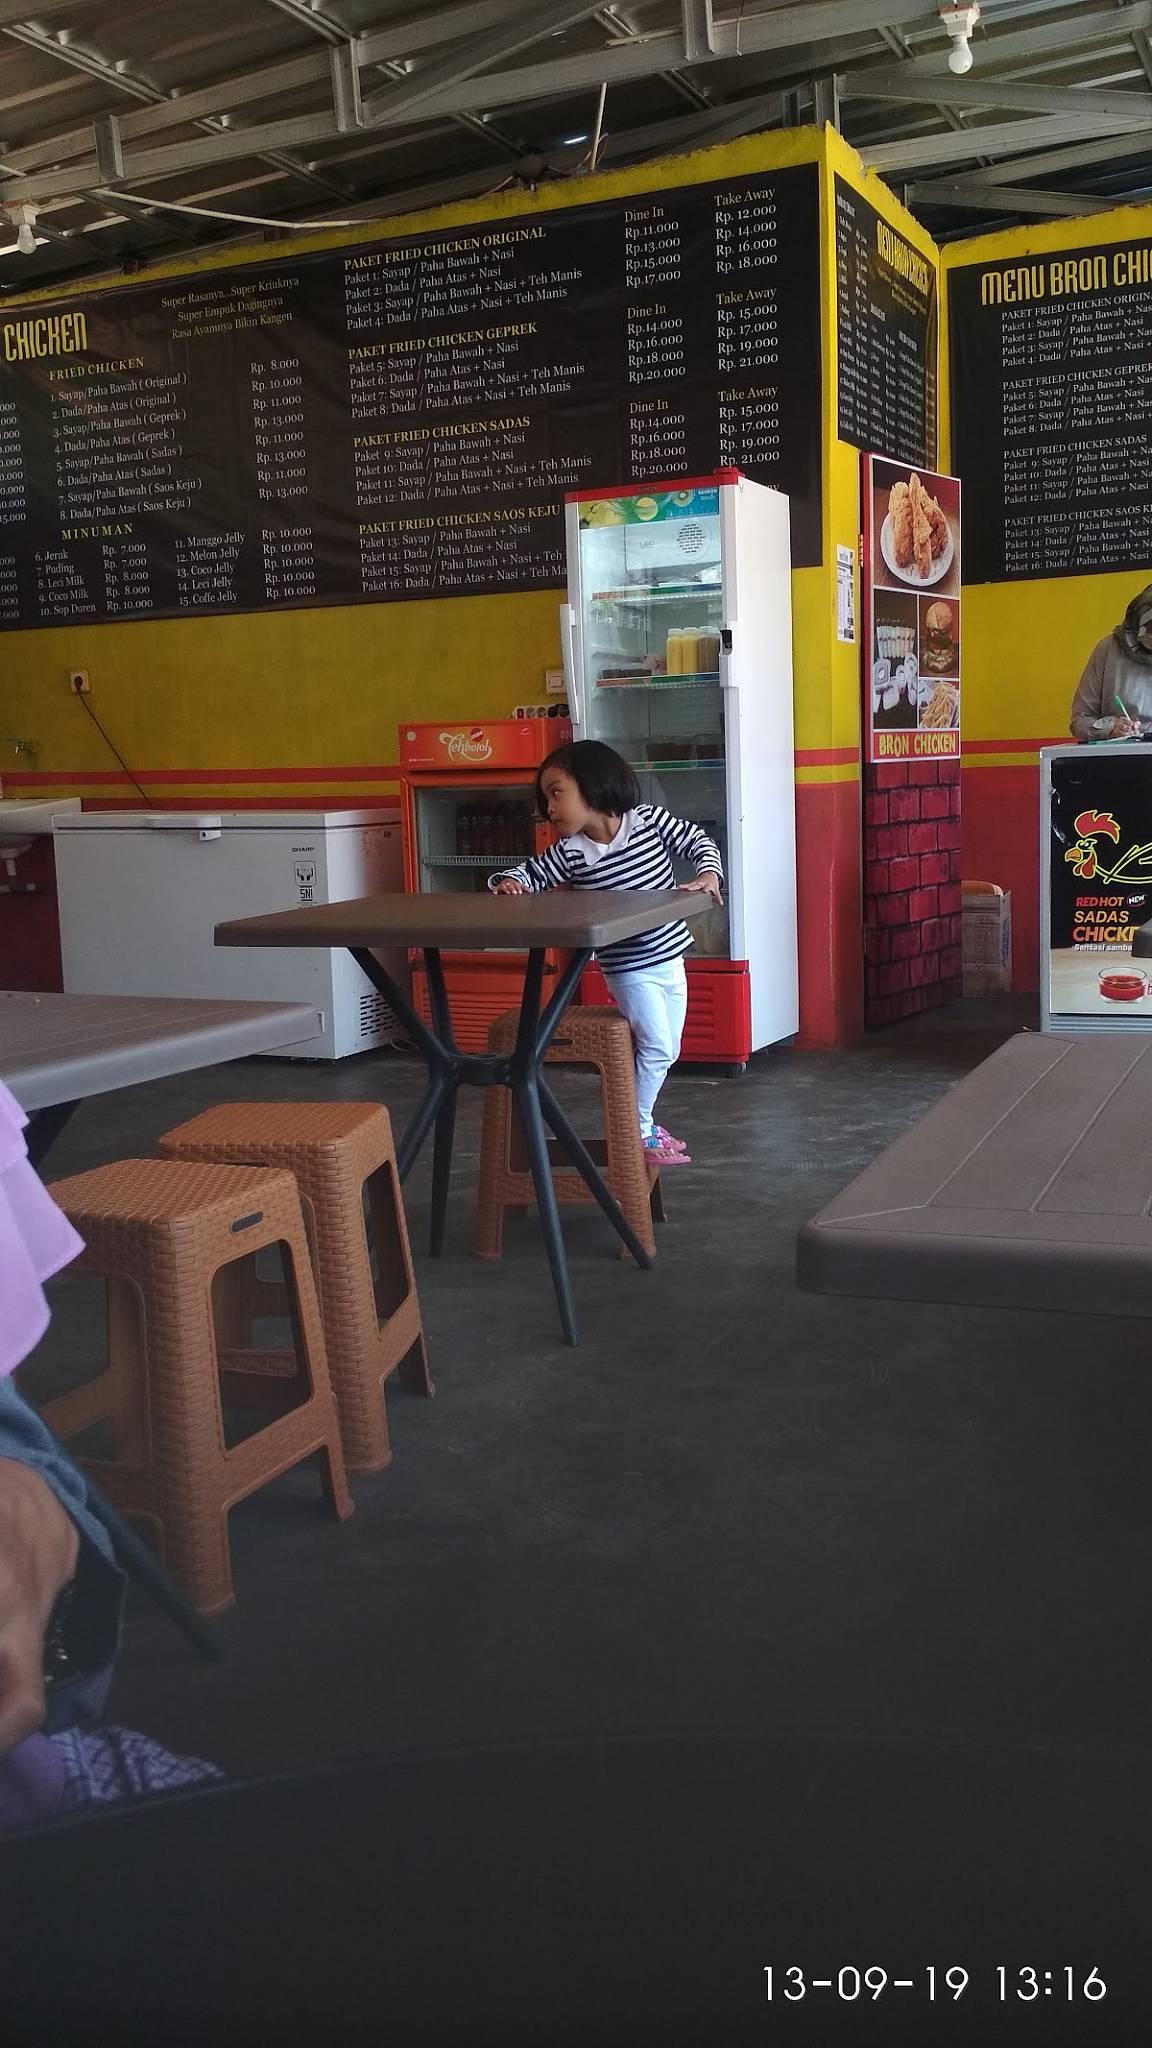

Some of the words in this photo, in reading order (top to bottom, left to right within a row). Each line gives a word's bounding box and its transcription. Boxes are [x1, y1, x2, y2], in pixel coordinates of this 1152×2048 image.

[714, 193, 742, 206] Take
[744, 188, 775, 203] Away
[625, 208, 650, 223] Dine
[652, 206, 664, 217] In
[715, 211, 734, 225] Rp.
[737, 204, 776, 220] 12.000
[625, 222, 679, 240] Rp.11.000
[716, 227, 735, 242] Rp.
[737, 221, 776, 237] 14.000
[344, 255, 382, 271] PAKET
[385, 248, 421, 264] FRIED
[424, 238, 480, 257] CHICKEN
[482, 227, 546, 247] ORIGINAL
[625, 238, 680, 255] Rp.13.000
[716, 244, 735, 258] Rp.
[738, 238, 777, 254] 16.000
[345, 273, 370, 286] Paket
[382, 266, 411, 281] Sayap
[420, 261, 444, 273] Paha
[447, 255, 480, 269] Bawah
[492, 248, 514, 261] Nasi
[625, 254, 681, 272] Rp.15.000
[716, 260, 735, 275] Rp.
[738, 254, 778, 269] 18.000
[626, 270, 681, 288] Rp.17.000
[981, 265, 1044, 305] MENU
[1050, 255, 1107, 296] BRON
[1113, 249, 1152, 286] CHI
[716, 292, 743, 305] Take
[746, 287, 777, 301] Away
[178, 311, 203, 322] Super
[204, 306, 236, 318] Empuk
[627, 306, 652, 319] Dine
[654, 304, 666, 315] In
[717, 310, 736, 323] Rp.
[739, 304, 778, 319] 15.000
[1001, 309, 1033, 321] PAKET
[1035, 304, 1065, 316] FRIED
[1066, 297, 1111, 312] CHICKEN
[627, 319, 682, 335] Rp.14.000
[717, 326, 736, 340] Rp.
[739, 321, 778, 337] 17.000
[4, 312, 87, 361] CHICKEN
[348, 344, 387, 360] PAKET
[389, 339, 425, 355] FRIED
[428, 329, 484, 350] CHICKEN
[486, 322, 538, 340] GEPREK
[628, 335, 683, 351] Rp.16.000
[717, 342, 736, 356] Rp.
[739, 337, 778, 352] 19.000
[251, 362, 266, 374] Rp.
[271, 358, 299, 371] 8.000
[628, 351, 684, 367] Rp.18.000
[718, 359, 736, 372] Rp.
[739, 353, 779, 367] 21.000
[50, 366, 85, 381] FRIED
[88, 357, 145, 375] CHICKEN
[629, 367, 686, 383] Rp.20.000
[252, 380, 267, 392] Rp.
[270, 376, 302, 389] 10.000
[718, 390, 745, 403] Take
[747, 385, 779, 400] Away
[253, 399, 268, 410] Rp.
[271, 395, 302, 407] 11.000
[630, 401, 655, 413] Dine
[657, 399, 669, 410] In
[719, 407, 737, 420] Rp.
[740, 403, 779, 418] 15.000
[254, 416, 269, 428] Rp.
[272, 413, 304, 426] 13.000
[630, 415, 685, 430] Rp.14.000
[719, 423, 737, 436] Rp.
[741, 419, 779, 434] 17.000
[256, 435, 269, 446] Rp.
[274, 432, 304, 443] 11.000
[354, 434, 392, 448] PAKET
[394, 429, 430, 443] FRIED
[432, 421, 489, 439] CHICKEN
[489, 416, 530, 431] SADAS
[630, 431, 685, 446] Rp.16.000
[719, 439, 737, 451] Rp.
[741, 435, 780, 451] 19.000
[256, 452, 272, 464] Rp.
[275, 450, 306, 463] 13.000
[631, 446, 686, 462] Rp.18.000
[720, 455, 738, 467] Rp.
[741, 451, 780, 465] 21.000
[257, 470, 272, 482] Rp.
[276, 467, 306, 479] 11.000
[631, 462, 688, 478] Rp.20.000
[259, 488, 274, 500] Rp.
[277, 486, 308, 499] 13.000
[359, 522, 397, 535] PAKET
[399, 518, 434, 530] FRIED
[436, 512, 492, 528] CHICKEN
[494, 508, 525, 521] SAOS
[527, 505, 560, 517] KEJU
[187, 536, 222, 549] Manggo
[224, 532, 245, 544] Jelly
[262, 529, 277, 541] Rp.
[280, 527, 312, 538] 10.000
[102, 545, 116, 556] Rp.
[121, 544, 146, 554] 7.000
[190, 550, 217, 562] Melon
[219, 547, 240, 560] Jelly
[263, 544, 278, 556] Rp.
[281, 542, 313, 553] 10.000
[45, 564, 74, 576] Puding
[191, 565, 213, 576] Coco
[214, 562, 234, 574] Jelly
[264, 559, 279, 570] Rp.
[282, 557, 314, 567] 10.000
[105, 573, 119, 584] Rp.
[123, 572, 149, 581] 8.000
[192, 579, 210, 590] Leci
[212, 577, 233, 589] Jelly
[265, 573, 280, 585] Rp.
[283, 571, 315, 581] 10.000
[193, 592, 215, 605] Coffe
[217, 591, 238, 603] Jelly
[266, 588, 281, 599] Rp.
[284, 586, 316, 597] 10.000
[878, 733, 910, 757] BRON
[914, 733, 955, 754] CHICKEN
[1076, 897, 1099, 907] RED
[1100, 897, 1124, 907] HOT
[1128, 895, 1146, 905] NEW
[1074, 910, 1129, 924] SADAS
